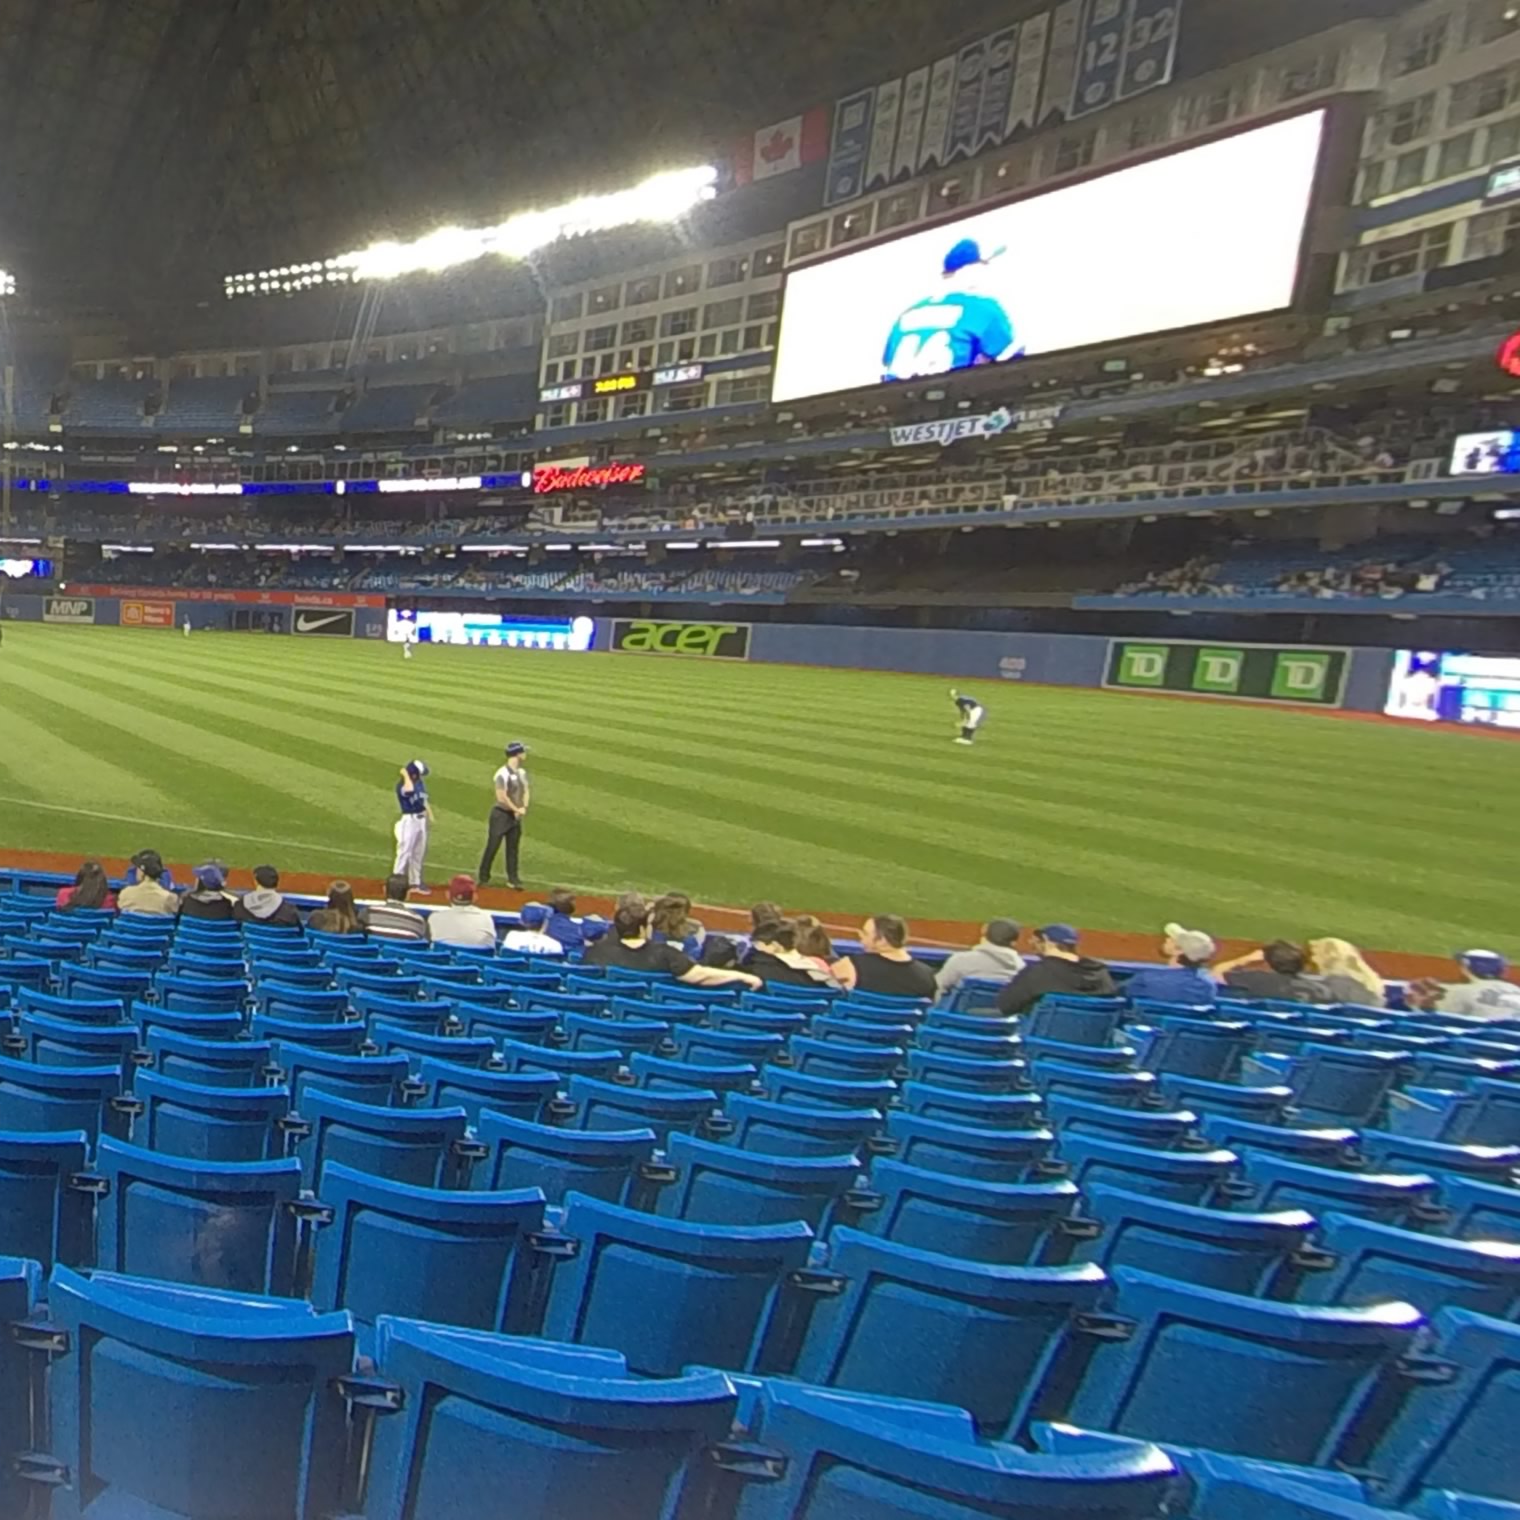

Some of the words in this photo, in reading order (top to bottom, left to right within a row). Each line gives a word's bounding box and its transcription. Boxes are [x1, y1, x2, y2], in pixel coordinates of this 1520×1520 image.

[1127, 7, 1175, 52] 32
[1086, 31, 1118, 72] 12
[892, 418, 979, 442] WESTJET
[534, 463, 644, 493] Budweiser
[50, 600, 88, 615] MNP
[621, 622, 737, 655] acer
[1128, 652, 1162, 677] TD
[1201, 656, 1238, 683] TD
[1282, 660, 1322, 689] TD
